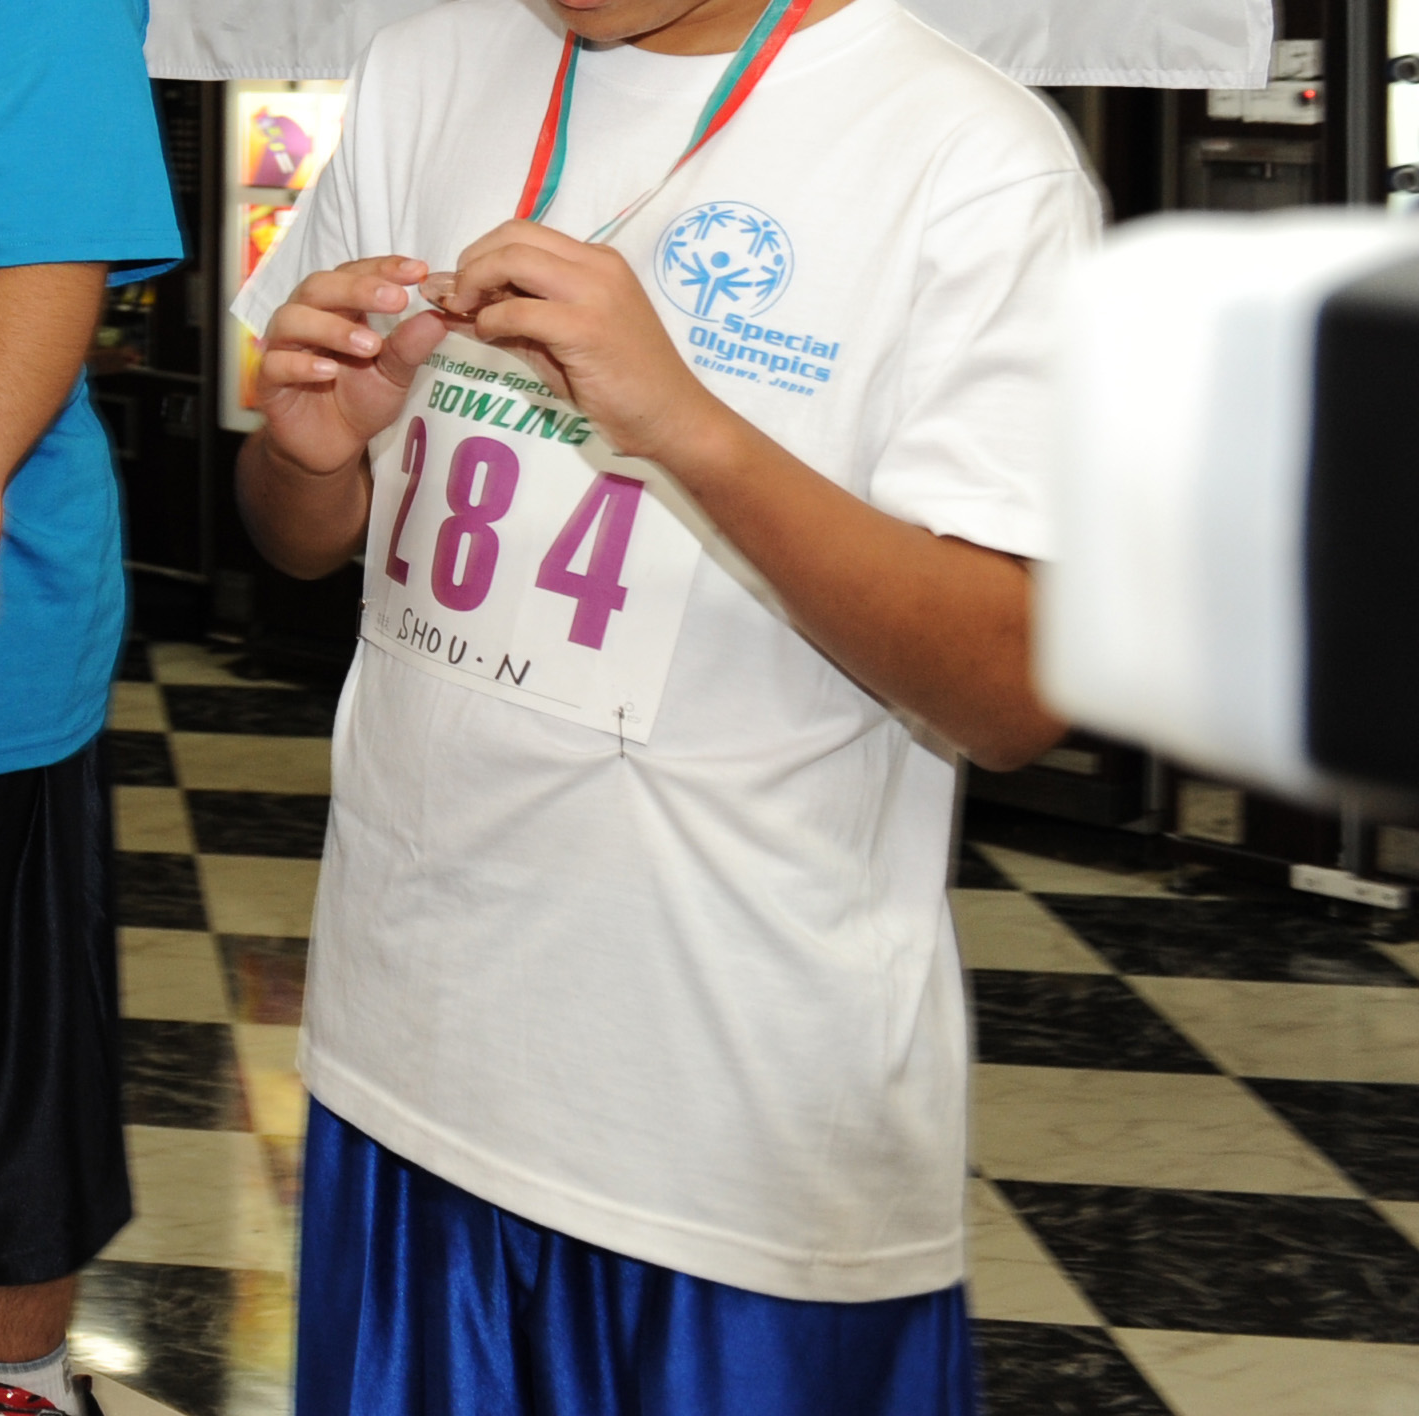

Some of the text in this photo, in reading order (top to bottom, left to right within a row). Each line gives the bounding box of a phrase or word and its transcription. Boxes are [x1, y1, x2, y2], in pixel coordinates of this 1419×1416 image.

[688, 326, 832, 383] Olympics
[721, 312, 841, 362] Special
[439, 356, 499, 384] Kadena
[768, 377, 816, 397] Japan
[427, 379, 591, 448] BOWLING
[385, 415, 646, 651] 284
